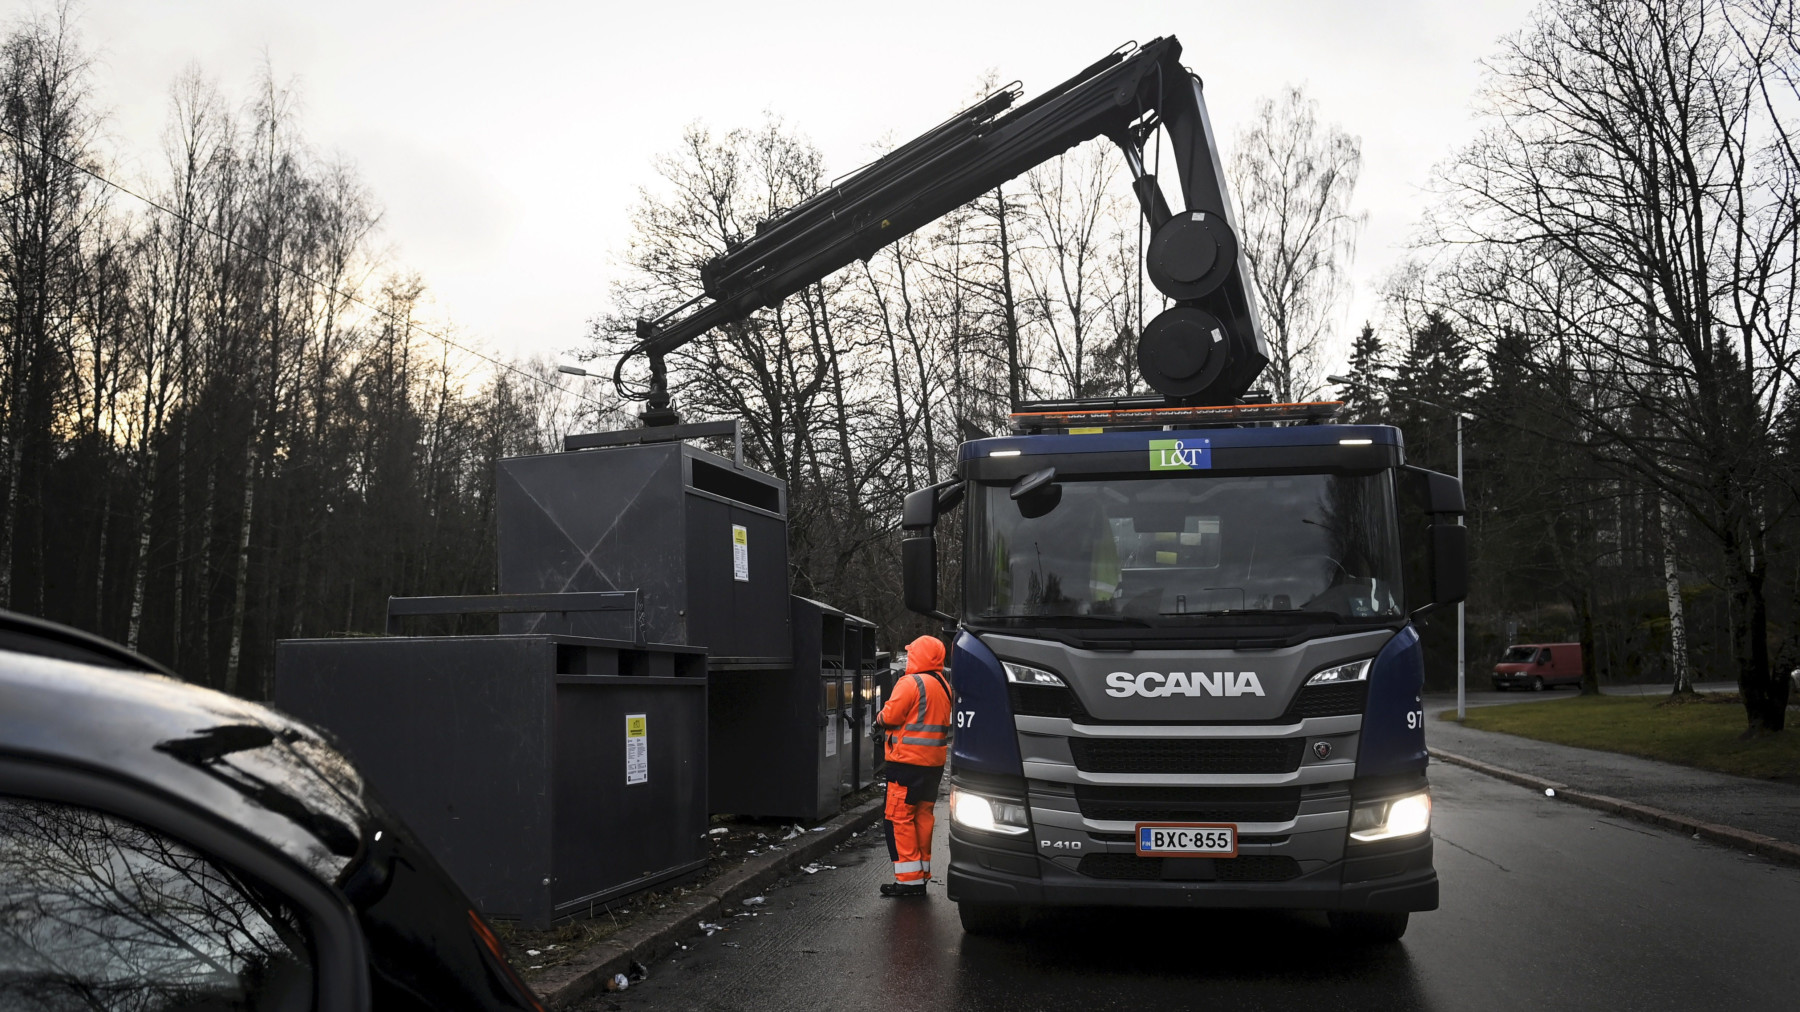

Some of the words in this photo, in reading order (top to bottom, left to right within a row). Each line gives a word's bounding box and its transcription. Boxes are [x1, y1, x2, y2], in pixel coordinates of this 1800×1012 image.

[1160, 441, 1202, 466] L&T
[1105, 671, 1266, 698] SCANIA
[957, 711, 976, 728] 97
[1406, 710, 1423, 729] 97
[1040, 840, 1051, 849] P
[1053, 840, 1082, 849] 410
[1154, 832, 1228, 848] BXC-855
